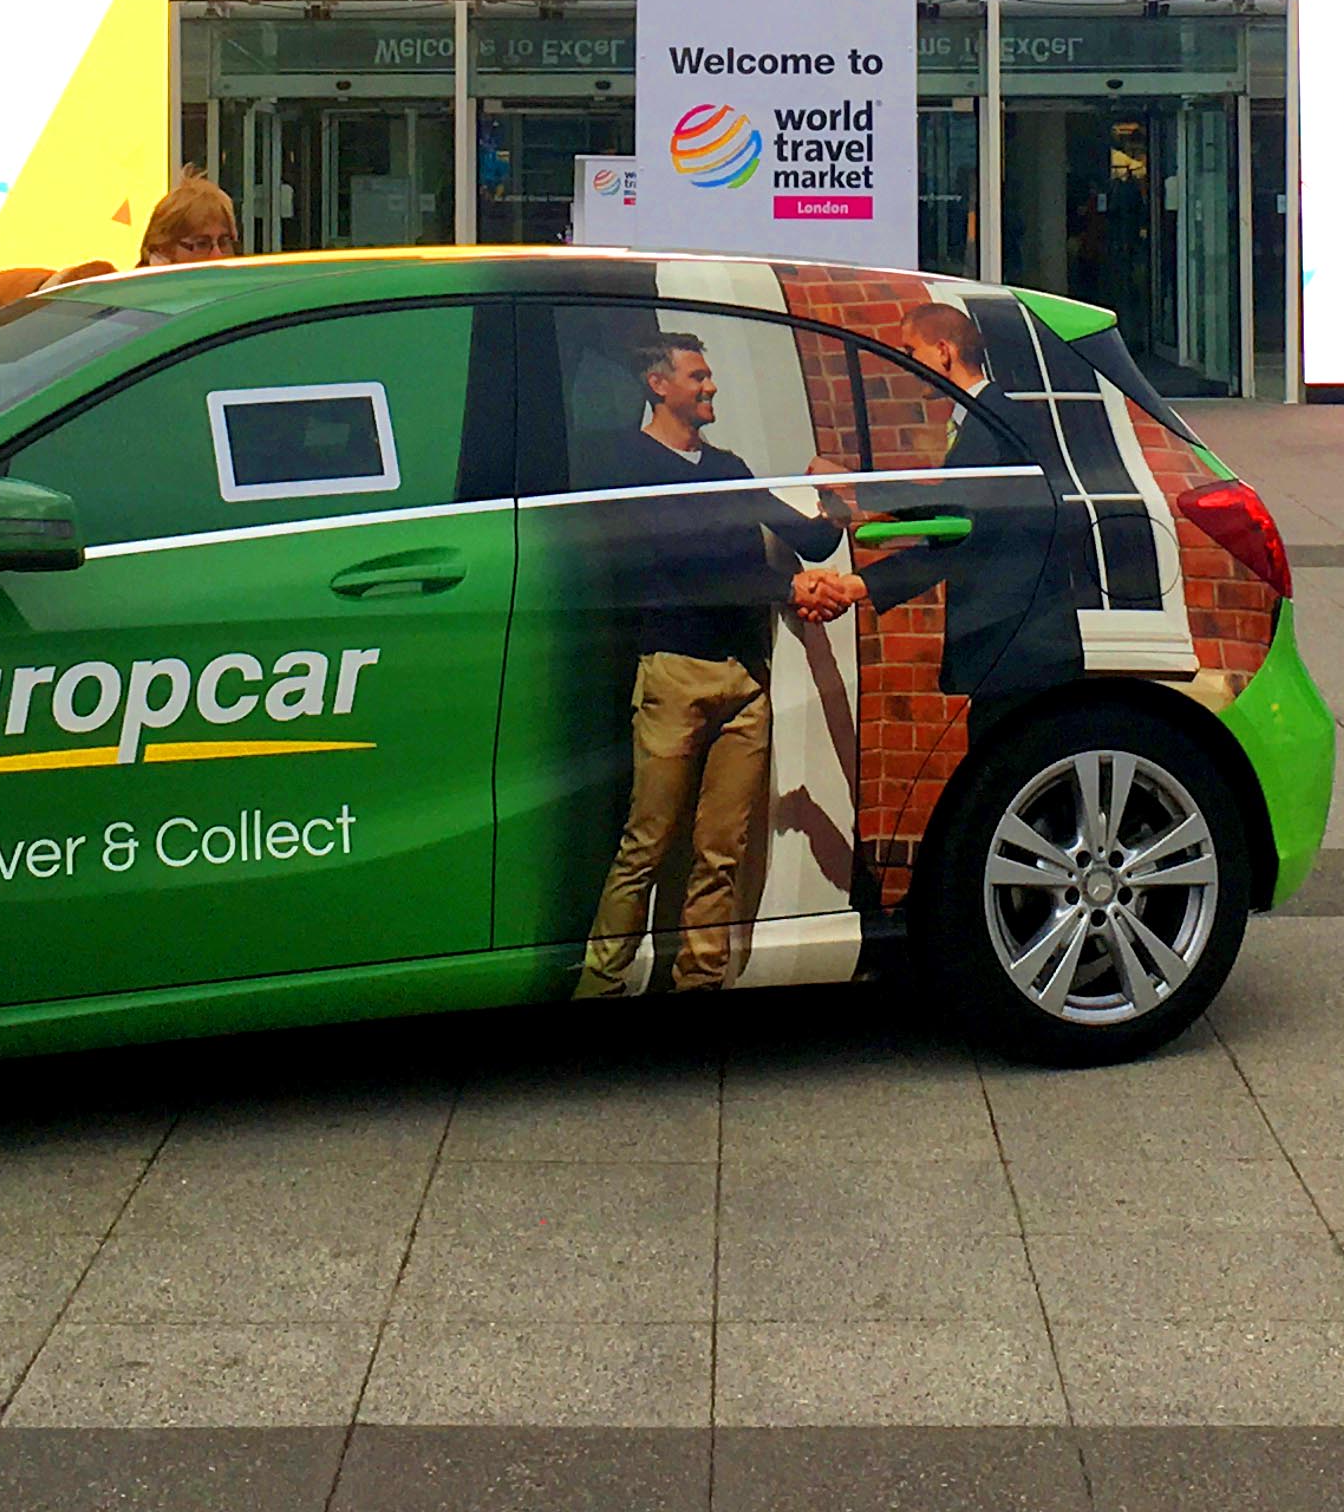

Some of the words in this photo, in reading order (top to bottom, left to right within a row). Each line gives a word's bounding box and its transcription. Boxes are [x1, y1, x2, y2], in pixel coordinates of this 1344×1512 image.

[669, 47, 835, 75] Welcome
[848, 48, 883, 75] to
[773, 100, 874, 131] world
[773, 133, 874, 162] travel
[773, 164, 874, 189] market
[797, 201, 849, 215] London
[102, 822, 139, 873] &
[155, 804, 356, 869] Collect
